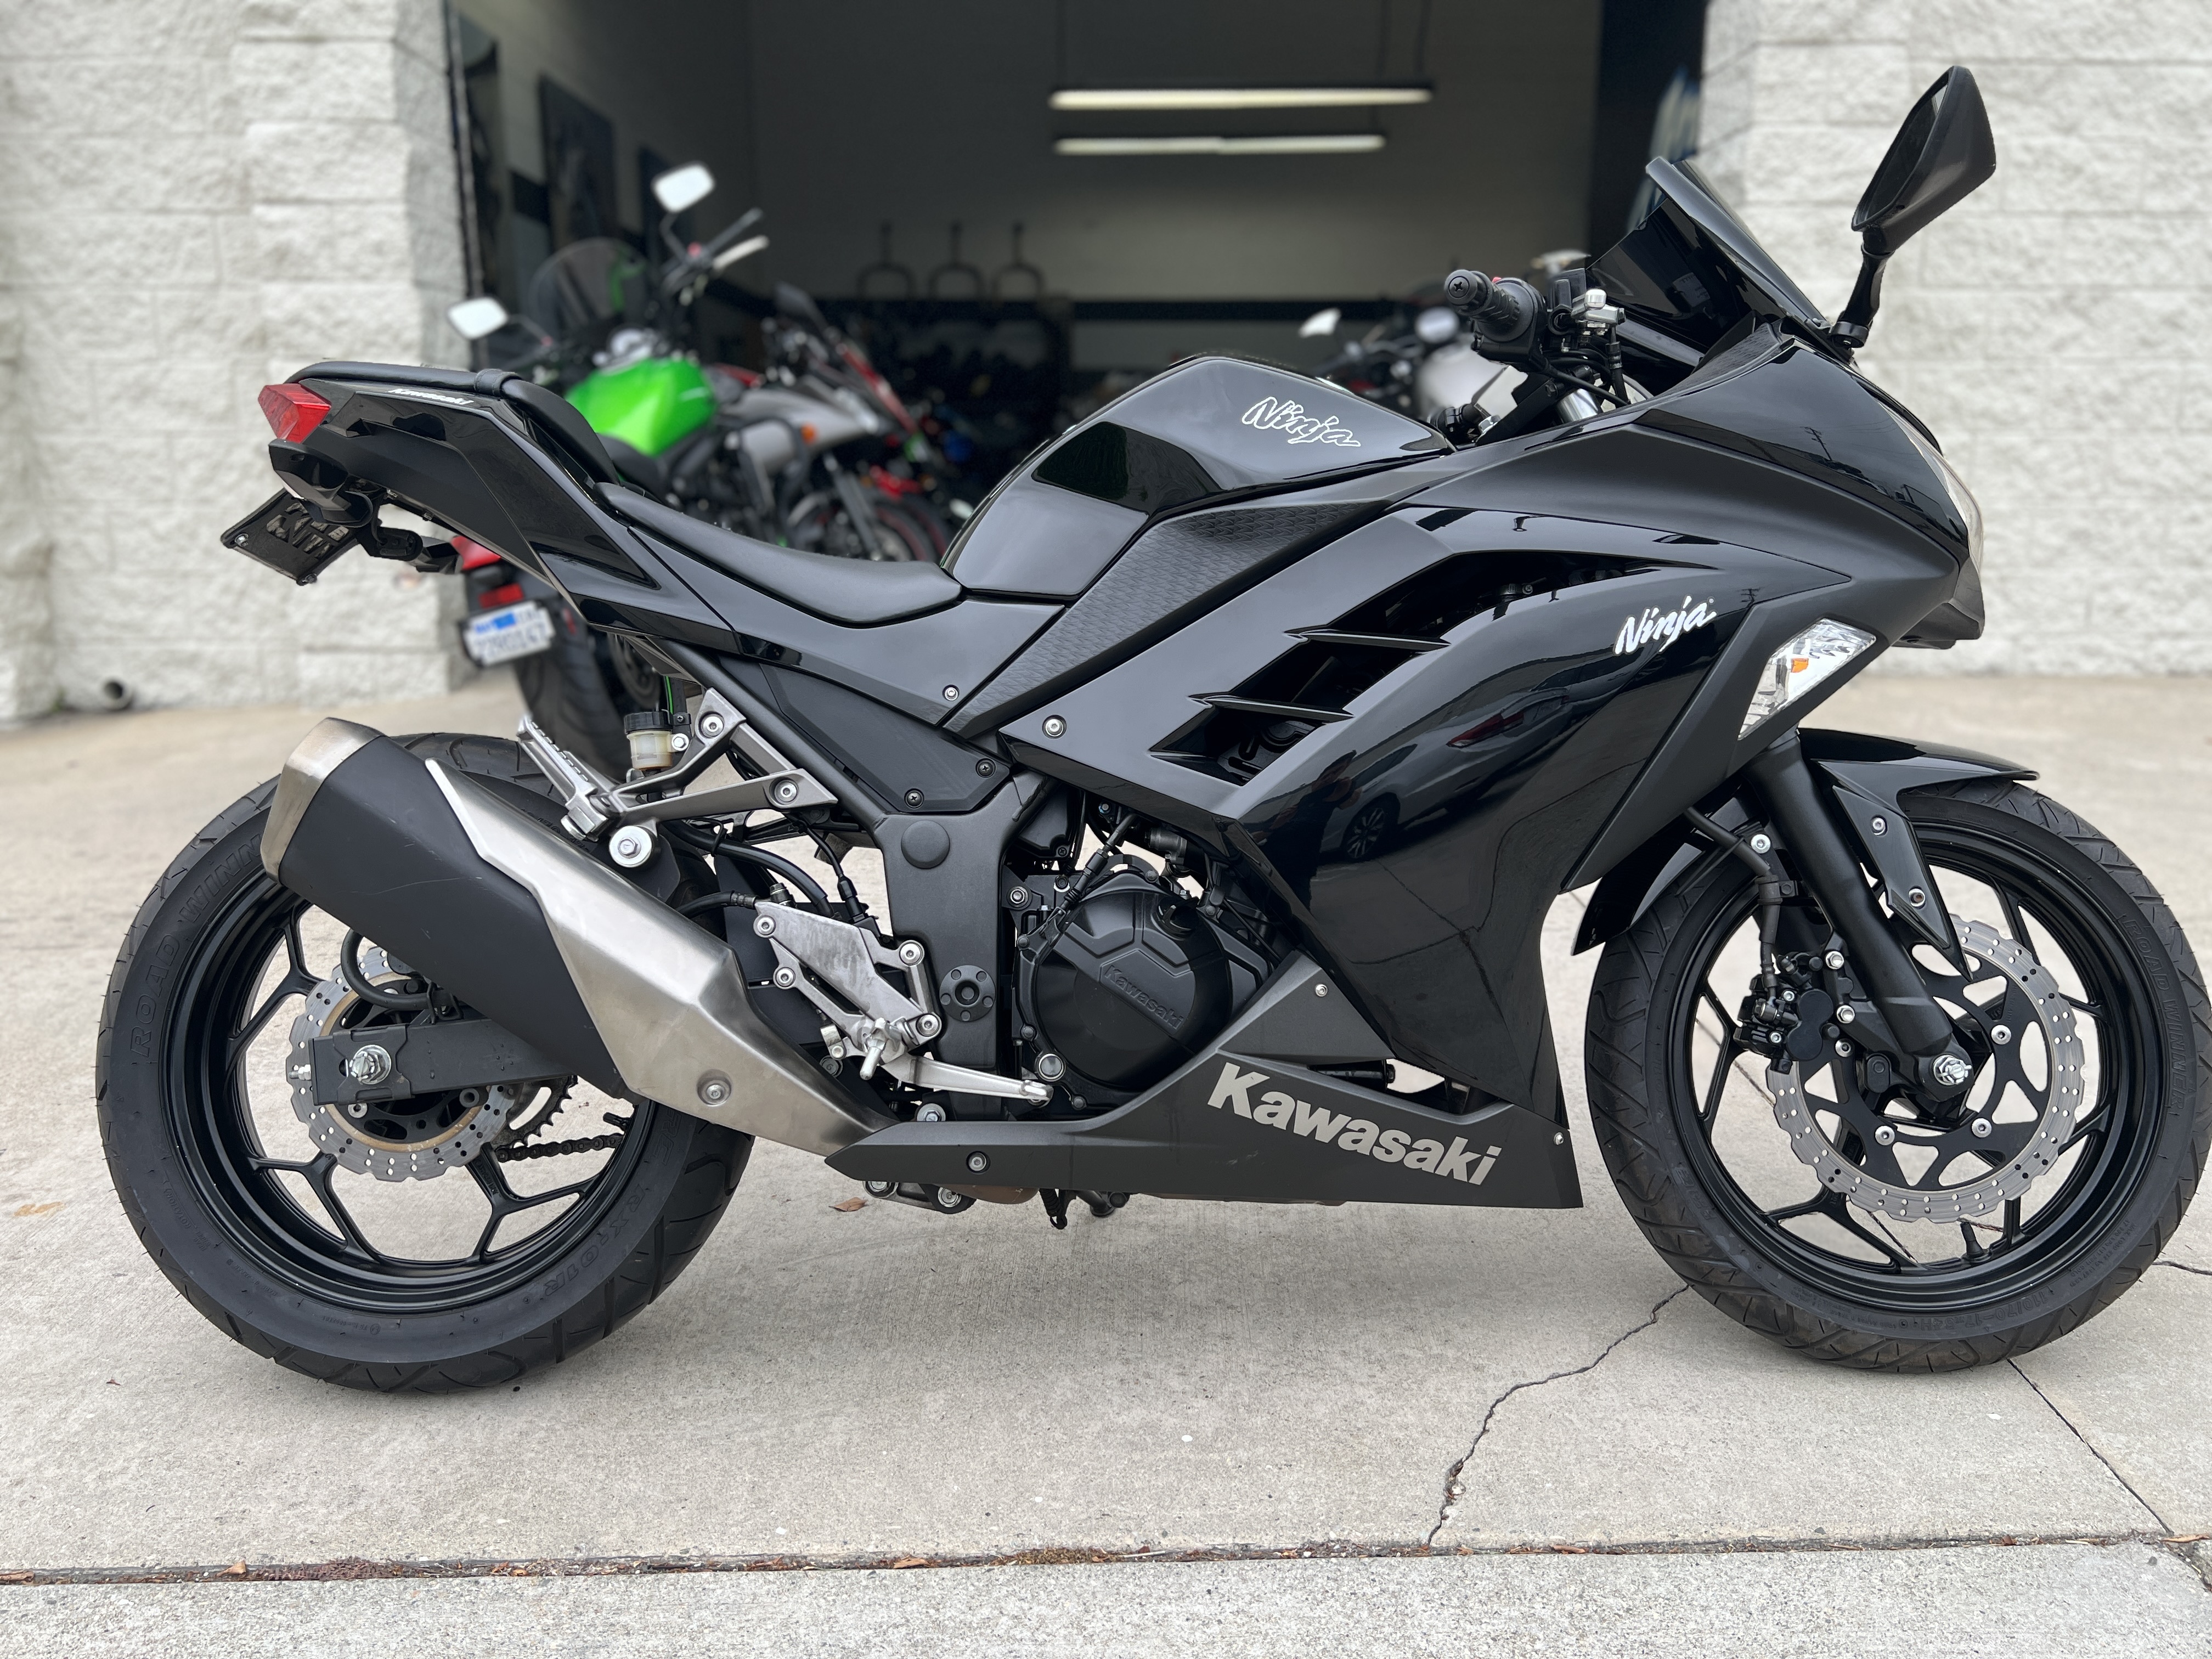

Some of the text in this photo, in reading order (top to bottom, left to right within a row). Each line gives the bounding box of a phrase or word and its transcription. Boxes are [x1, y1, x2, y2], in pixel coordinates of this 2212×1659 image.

[1242, 397, 1361, 447] Ninja
[1615, 595, 1717, 654] Ninja
[130, 835, 262, 1058] ROAD WINN
[1104, 964, 1184, 1030] Kawasaki
[2121, 918, 2189, 1109] ROAD WINNER
[1207, 1062, 1502, 1186] Kawasaki
